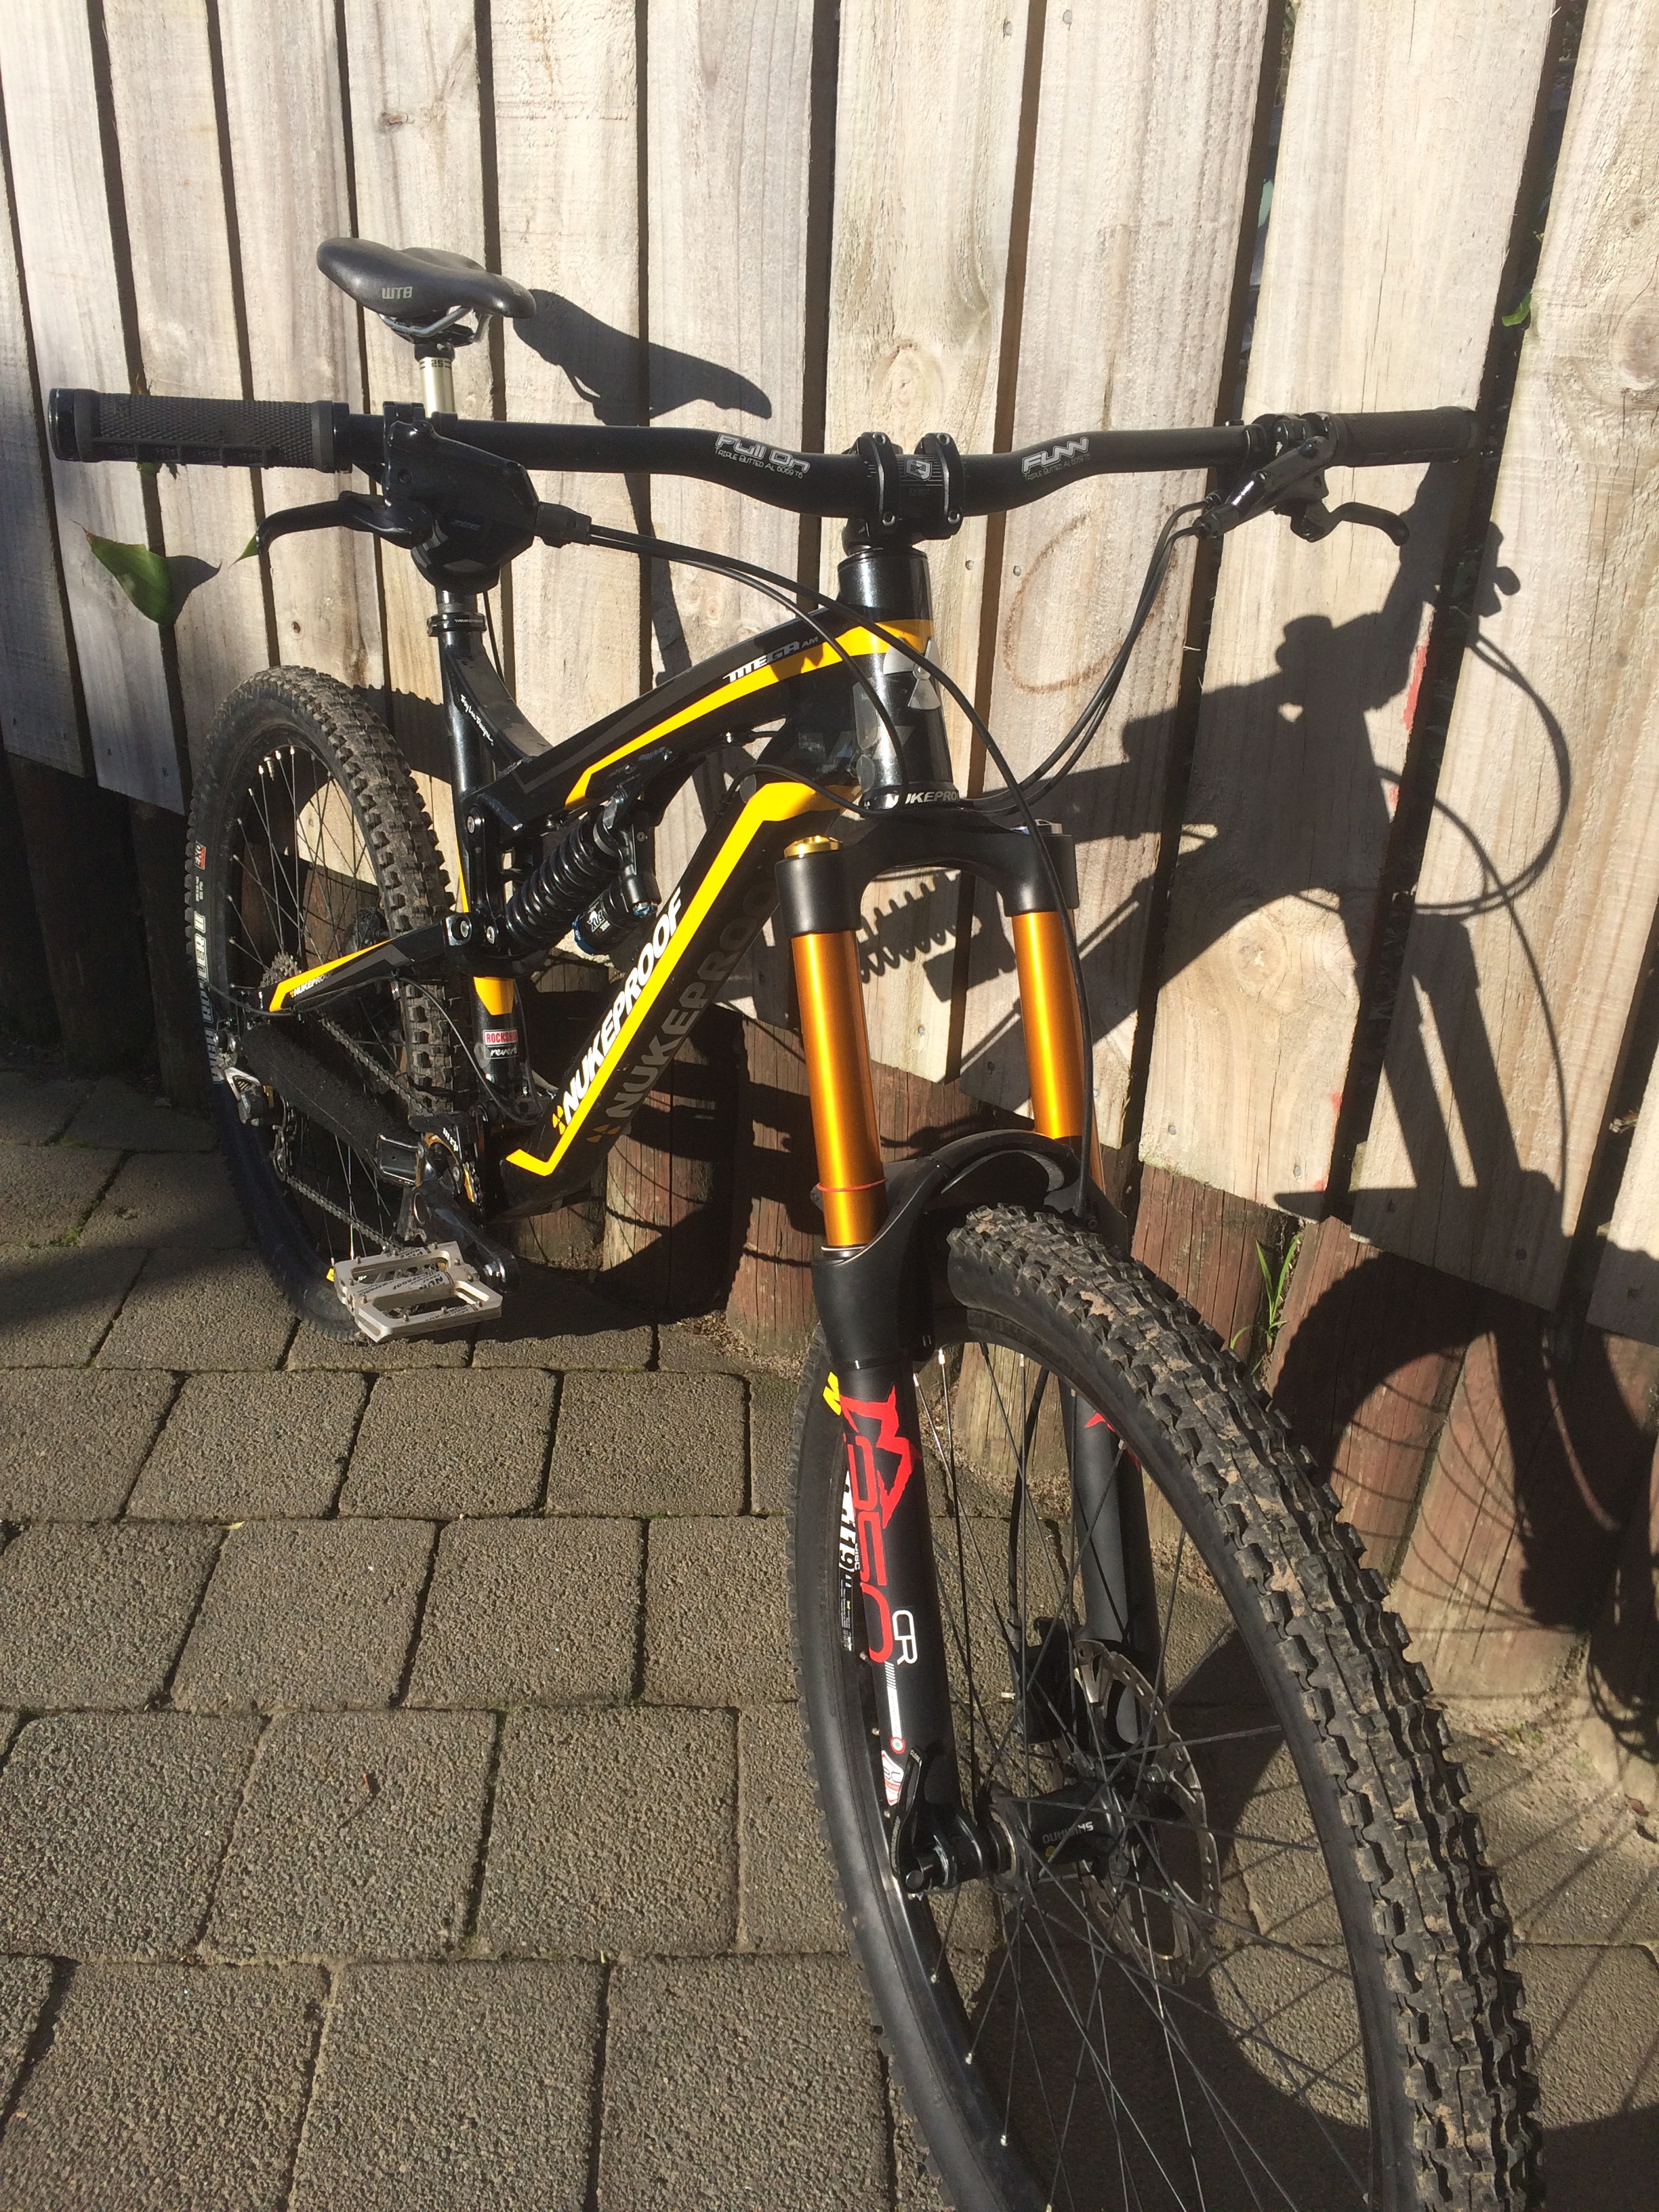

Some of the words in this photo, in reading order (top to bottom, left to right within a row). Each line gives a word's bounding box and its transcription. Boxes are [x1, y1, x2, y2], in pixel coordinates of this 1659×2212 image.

[381, 286, 413, 300] WTB
[800, 636, 819, 648] AM
[562, 886, 684, 1125] NUKEPROOF
[892, 1610, 918, 1665] CR
